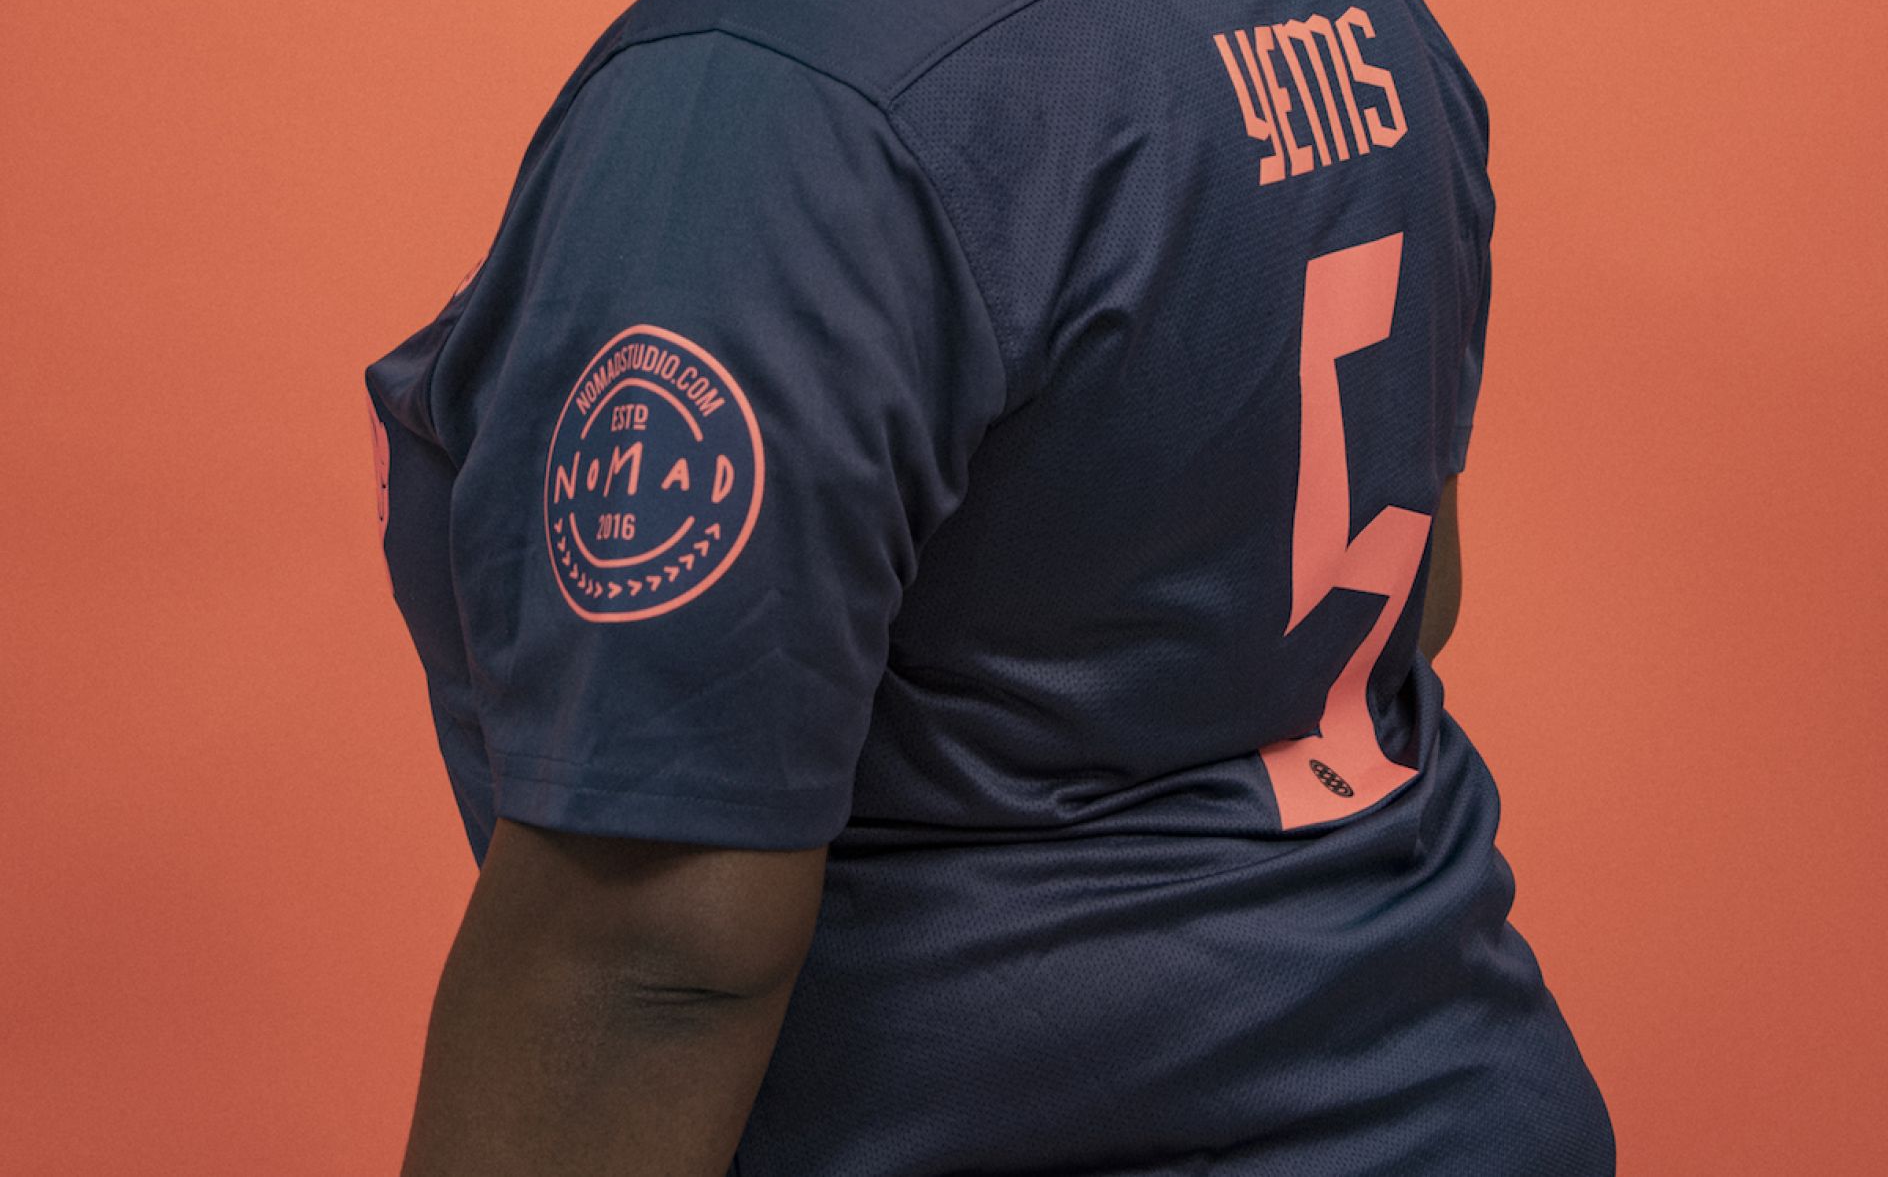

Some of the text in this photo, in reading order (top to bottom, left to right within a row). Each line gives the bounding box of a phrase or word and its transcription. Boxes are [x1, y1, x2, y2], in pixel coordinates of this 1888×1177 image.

[576, 343, 725, 416] NOMADSTUDIO.COM
[611, 404, 649, 431] ESTD
[554, 441, 734, 504] NOMAD
[596, 513, 636, 540] 2016
[1258, 232, 1432, 831] 5
